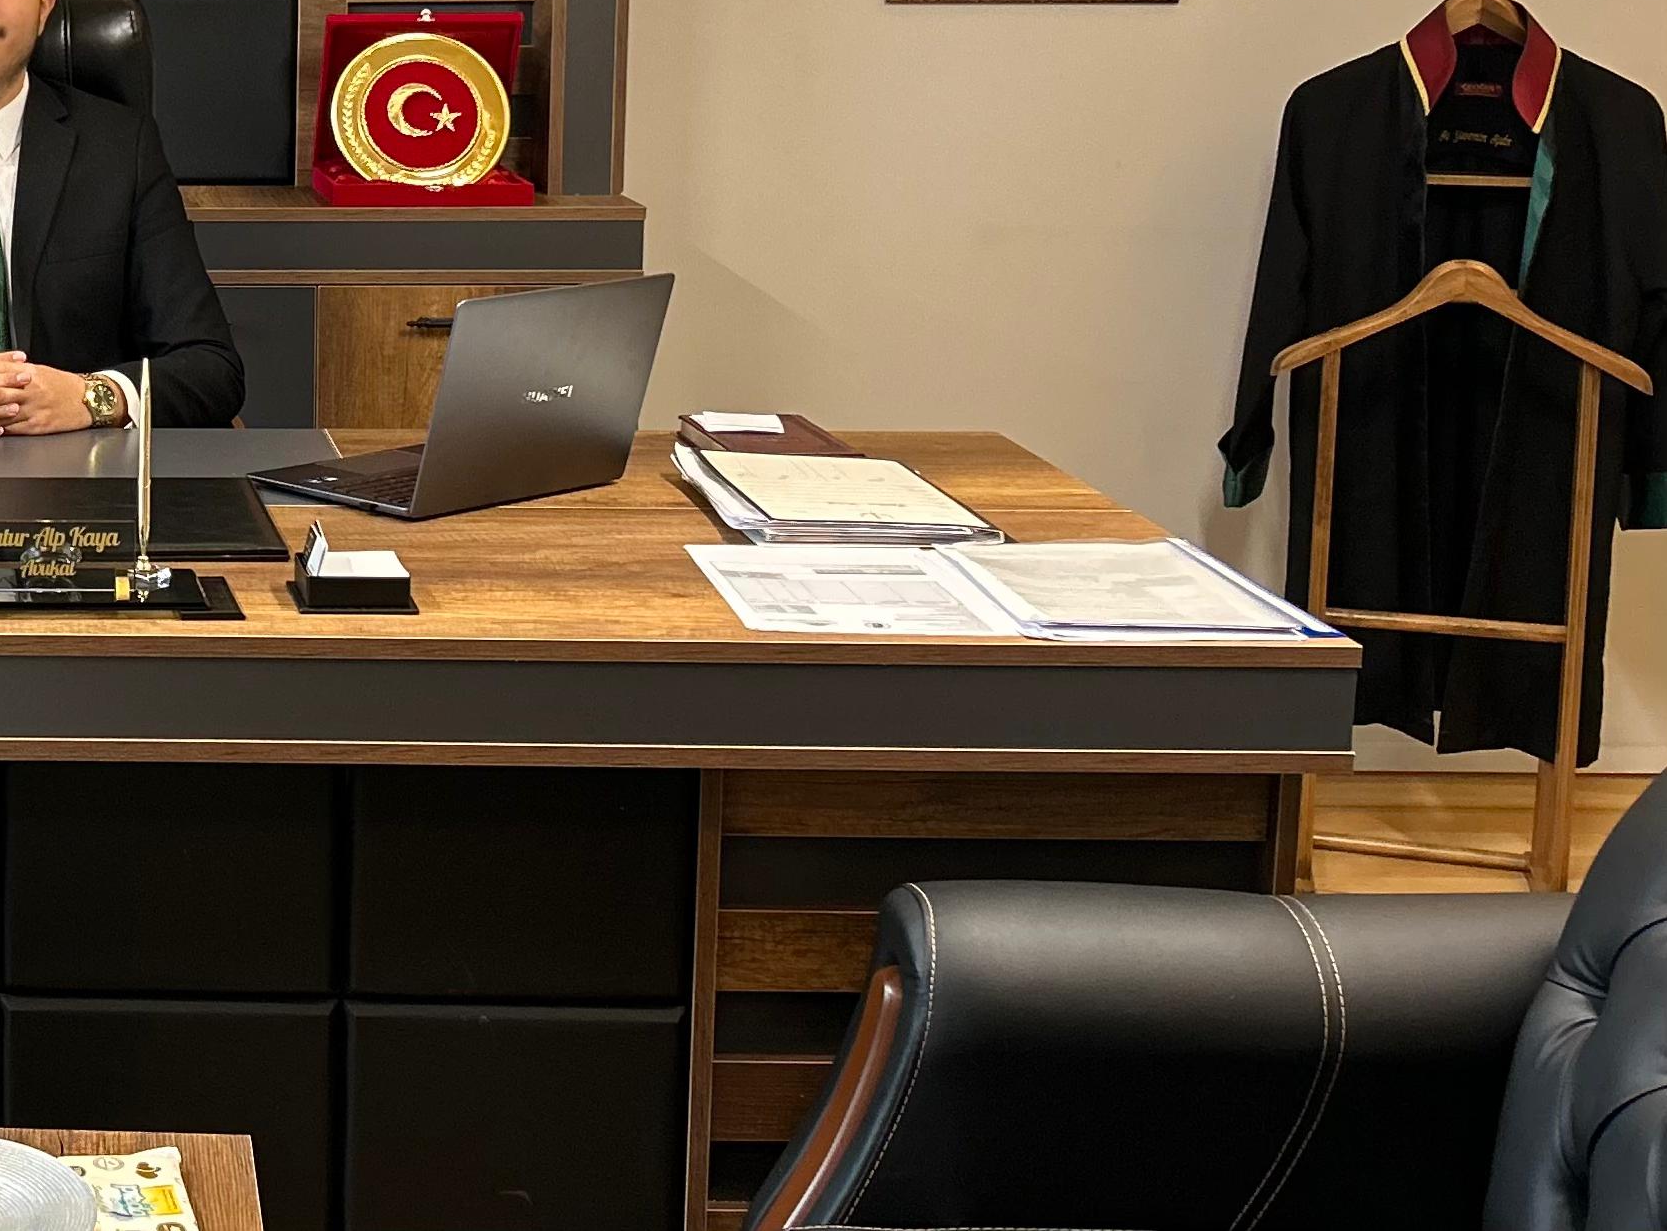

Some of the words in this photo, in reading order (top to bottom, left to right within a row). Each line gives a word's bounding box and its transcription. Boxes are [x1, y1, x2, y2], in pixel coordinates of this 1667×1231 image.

[33, 526, 65, 552] Alp
[69, 526, 122, 553] Kaya
[20, 559, 76, 578] Avukat
